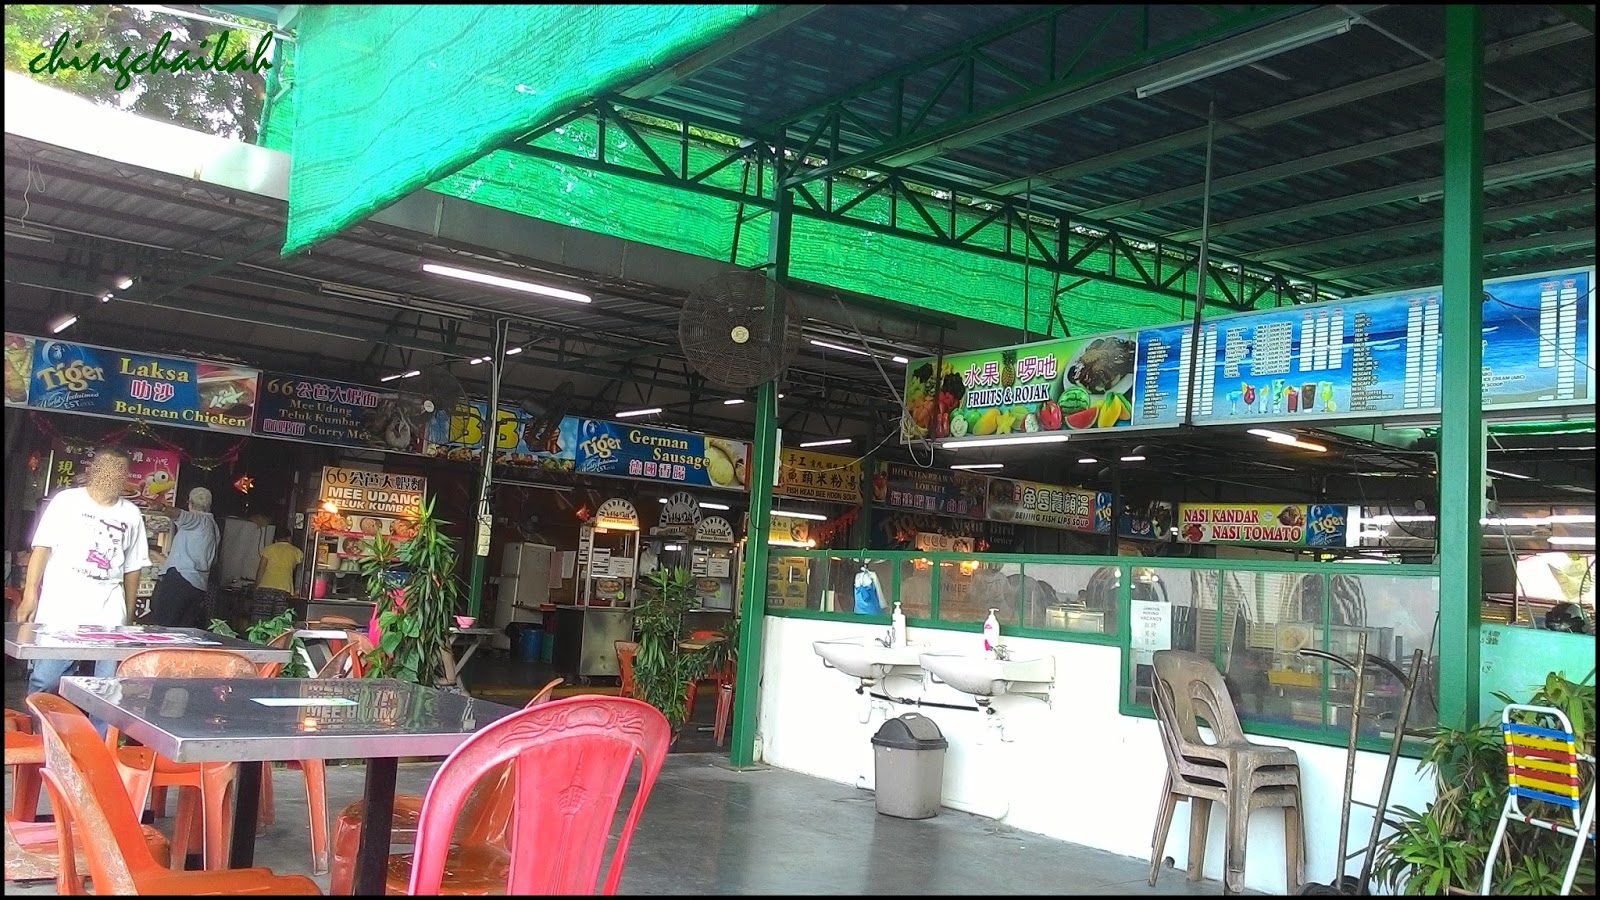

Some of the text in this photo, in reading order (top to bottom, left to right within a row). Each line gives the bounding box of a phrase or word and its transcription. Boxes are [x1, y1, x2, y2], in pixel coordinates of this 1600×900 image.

[37, 359, 105, 391] Tiger
[120, 357, 189, 382] Laksa
[964, 362, 1000, 388] 水果
[967, 384, 1050, 408] FRUITS & ROJAK
[114, 400, 246, 427] Belacan Chicken
[290, 399, 352, 417] Mee Udang
[279, 409, 360, 427] Teluk Kumbar
[309, 424, 372, 441] Curry Mee
[629, 429, 688, 449] German
[579, 433, 622, 459] Tiger
[652, 447, 711, 470] Sausage
[892, 468, 927, 479] HOKKIEN
[928, 472, 953, 483] PRAWN
[328, 486, 420, 506] MEE UDANG
[800, 488, 814, 496] HEAD
[827, 492, 842, 500] HOON
[915, 482, 930, 492] LOR
[327, 498, 420, 515] TELUK KUMBAR
[1015, 511, 1089, 527] BEIJING FISH LIPS SOUP
[1184, 509, 1208, 523] NASI
[1211, 509, 1259, 524] KANDAR
[1309, 514, 1345, 535] Tiger
[951, 519, 1015, 535] Night Bird
[1212, 526, 1240, 541] NASI
[1244, 525, 1301, 542] TOMATO
[990, 536, 1013, 545] Corner
